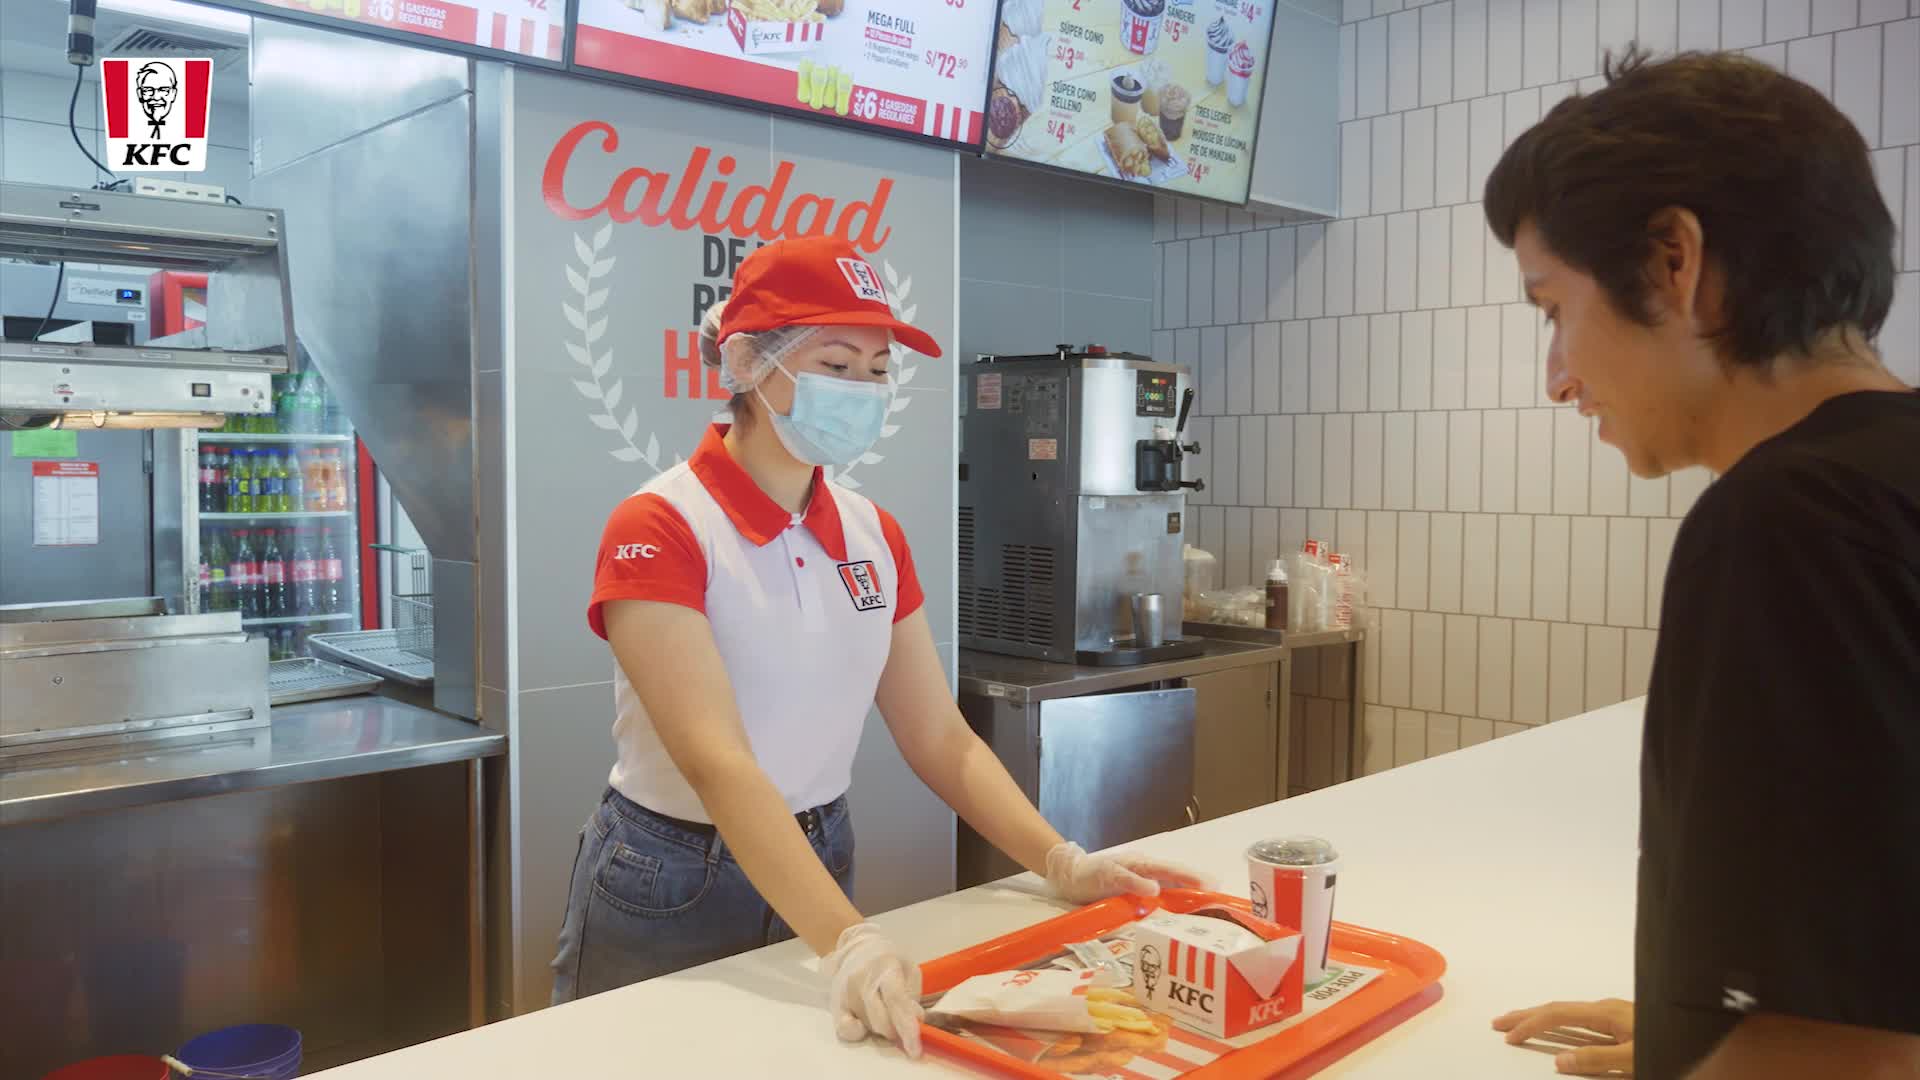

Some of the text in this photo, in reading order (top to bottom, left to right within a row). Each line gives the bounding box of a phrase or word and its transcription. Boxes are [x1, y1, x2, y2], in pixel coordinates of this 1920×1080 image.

[867, 10, 916, 35] MEGA FULL
[1084, 28, 1105, 46] CONO
[1050, 95, 1082, 113] RELLENO
[1077, 87, 1097, 103] CONO
[541, 120, 895, 254] Calidad
[861, 287, 882, 299] KFC
[614, 543, 661, 560] KFC
[861, 595, 883, 608] KFC
[1168, 980, 1214, 1014] KFC
[1248, 997, 1286, 1025] KFC
